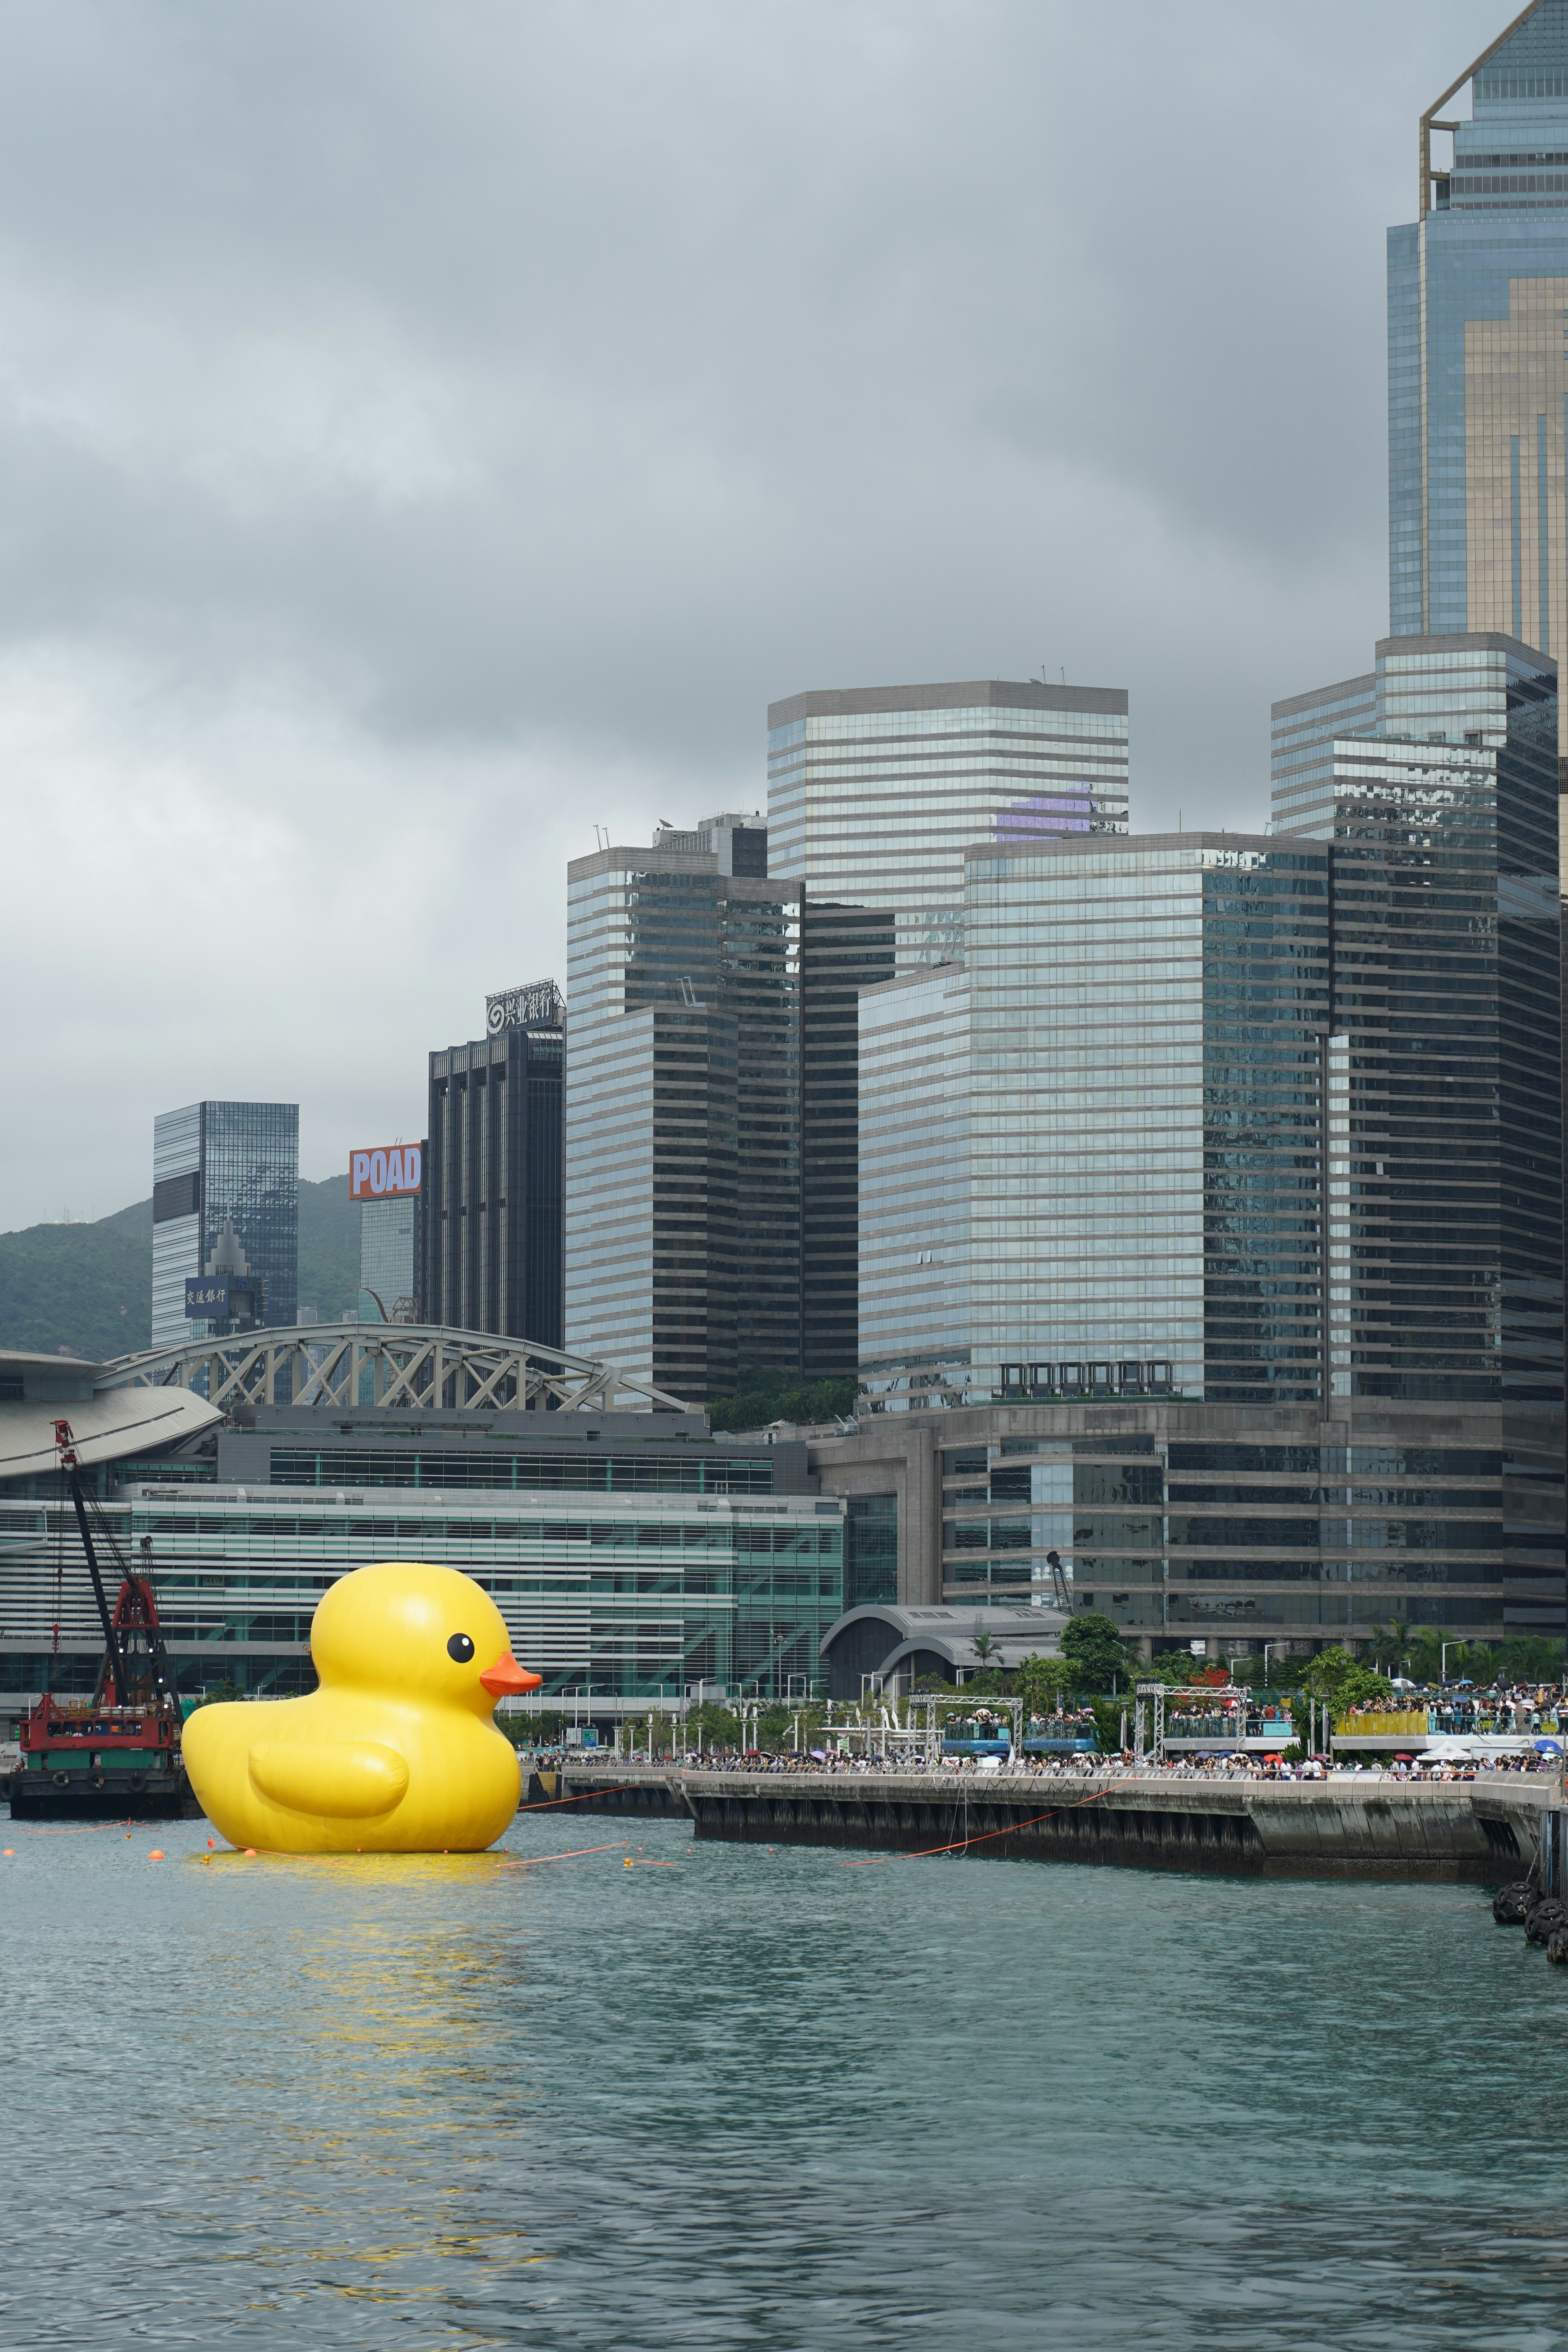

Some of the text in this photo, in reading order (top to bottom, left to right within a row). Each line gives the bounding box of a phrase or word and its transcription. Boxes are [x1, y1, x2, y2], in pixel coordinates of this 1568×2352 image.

[505, 988, 551, 1027] 兴业银行
[353, 1148, 421, 1194] POAD
[187, 1289, 226, 1305] 交通銀行
